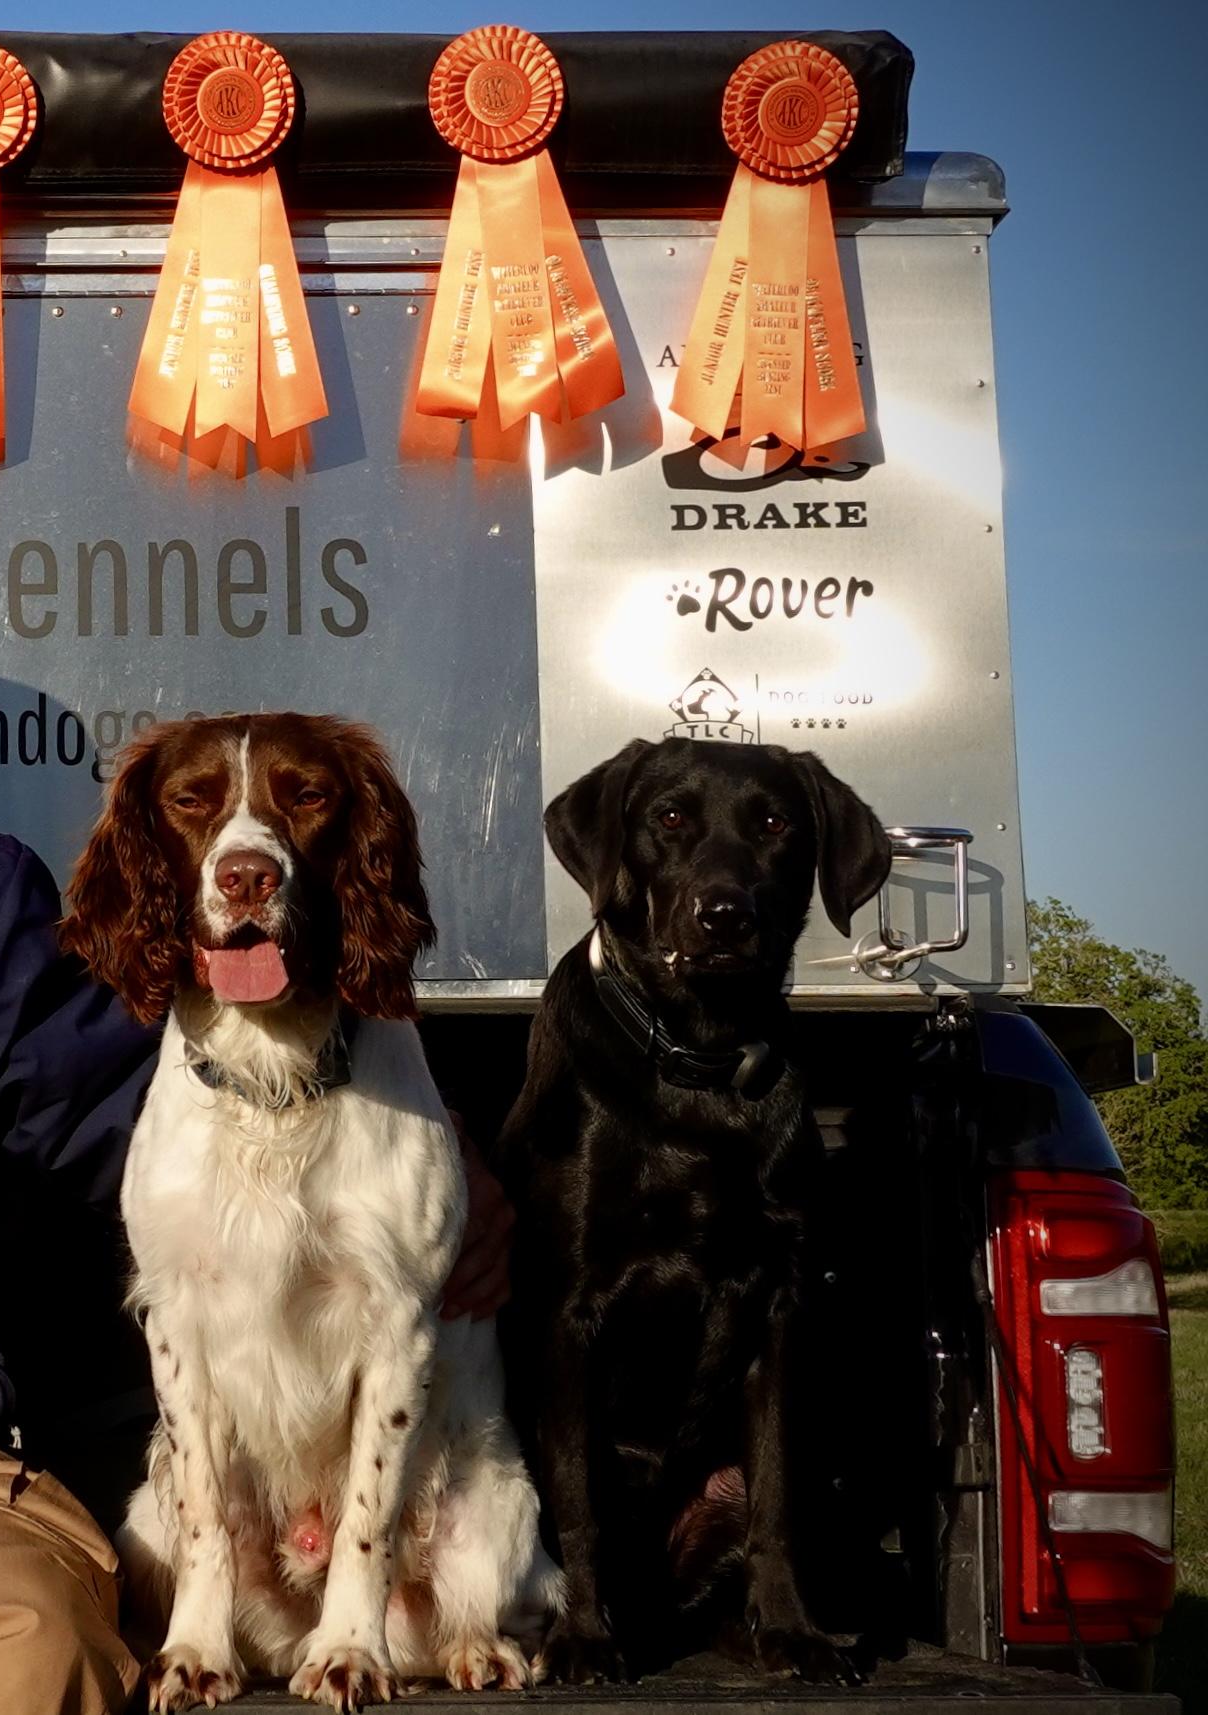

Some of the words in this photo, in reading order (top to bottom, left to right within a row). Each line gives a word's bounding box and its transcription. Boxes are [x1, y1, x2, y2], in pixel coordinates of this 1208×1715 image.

[778, 98, 808, 127] AKC
[701, 342, 725, 385] JUNIOR
[714, 291, 740, 338] HUNTER
[729, 257, 749, 285] TEST
[670, 501, 868, 530] DRAKE
[705, 567, 874, 633] Rover
[686, 724, 730, 739] TLC
